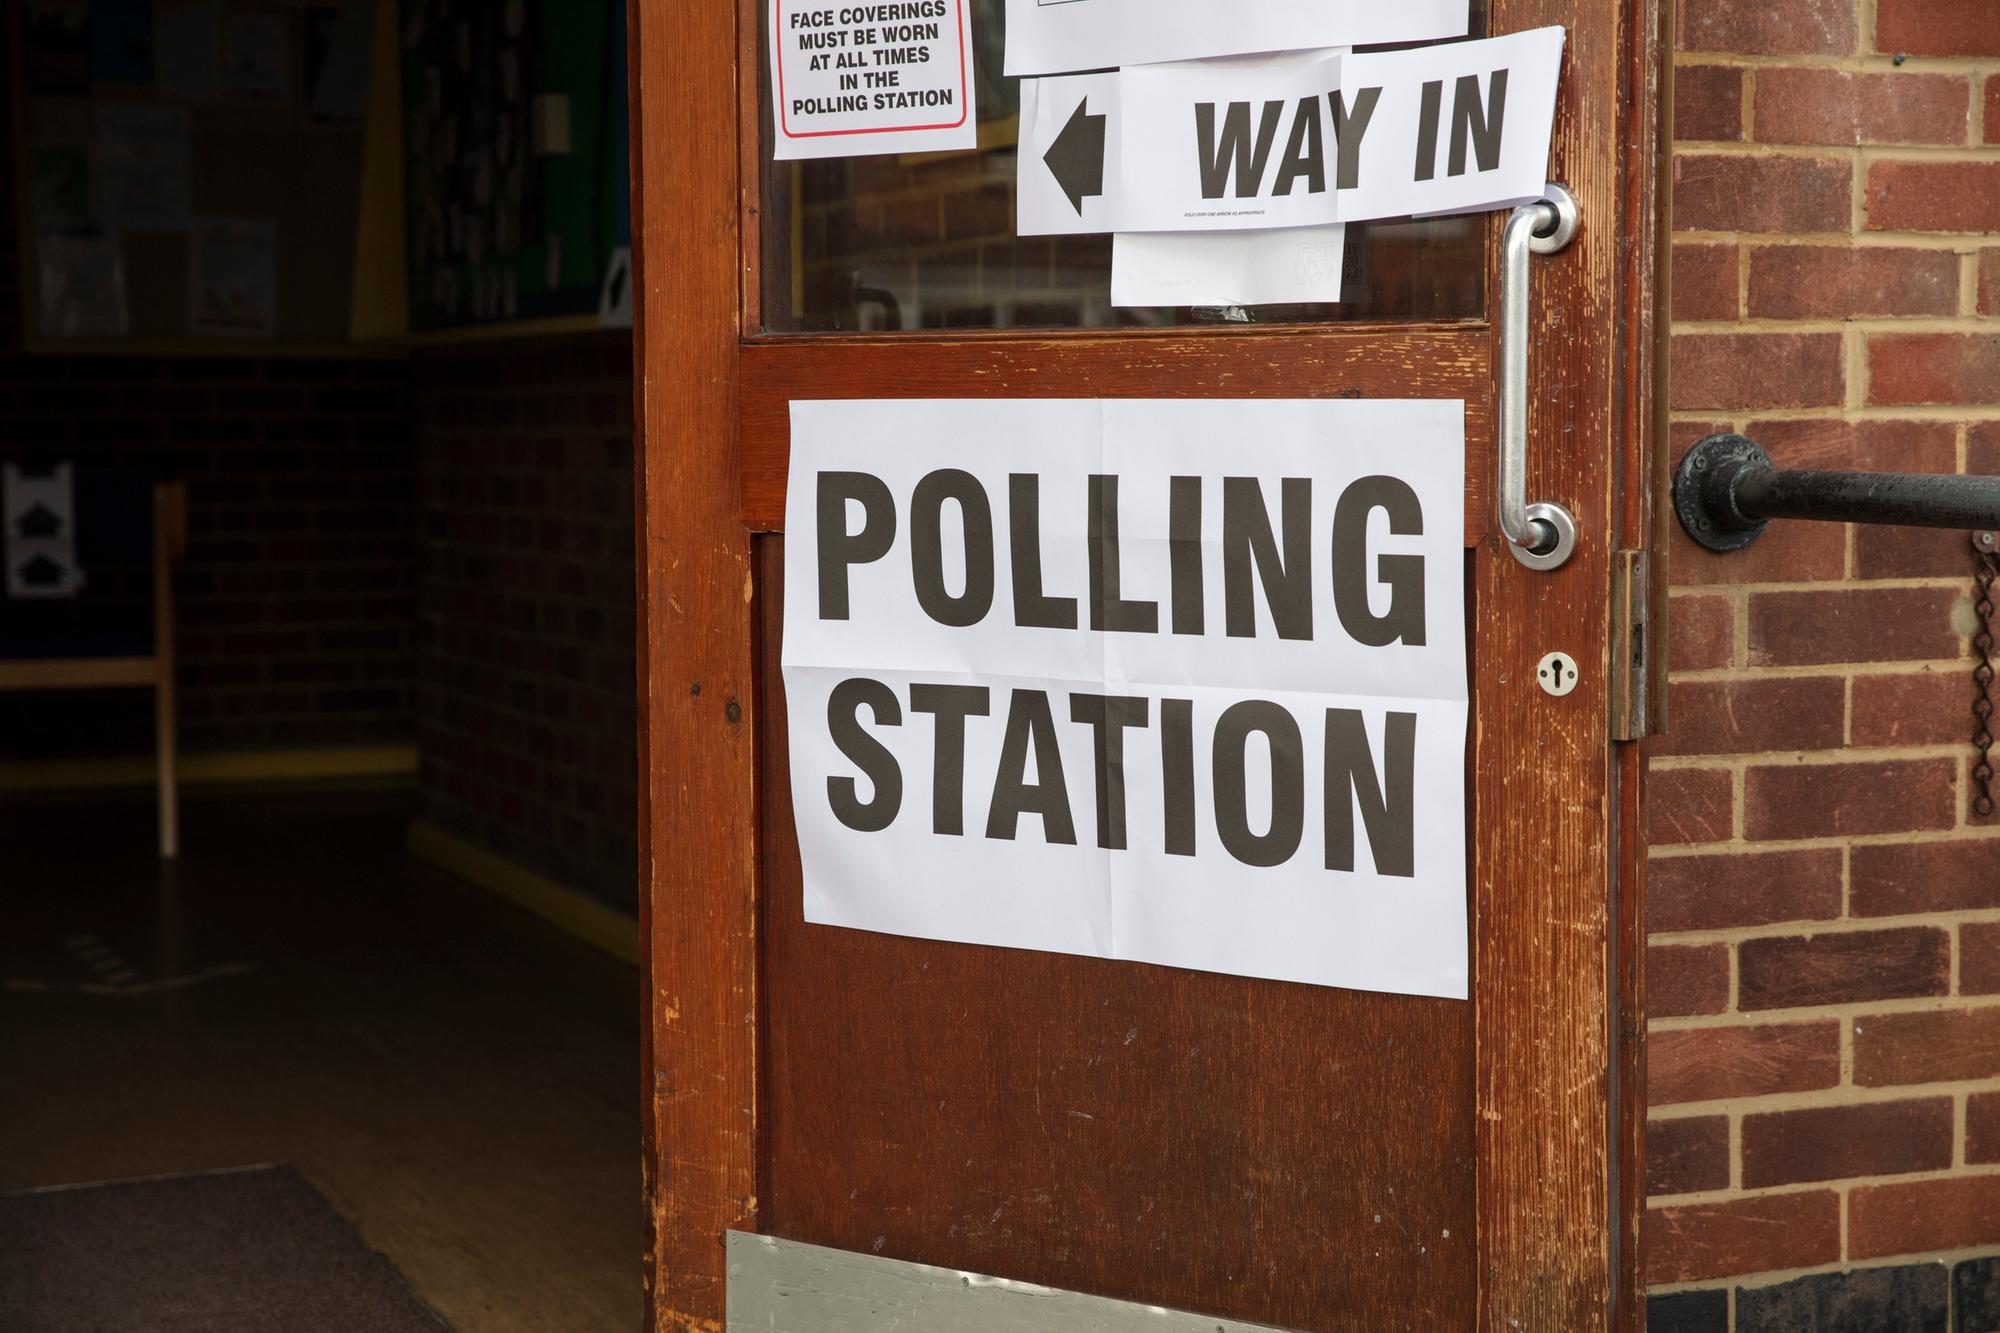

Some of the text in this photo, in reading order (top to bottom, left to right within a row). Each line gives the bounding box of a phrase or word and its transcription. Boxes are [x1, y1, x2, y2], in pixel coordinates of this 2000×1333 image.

[791, 0, 946, 29] FACE COVERINGS
[799, 23, 938, 50] MUST BE WORN
[810, 46, 929, 71] AT ALL TIMES
[840, 71, 899, 90] IN THE
[793, 89, 952, 115] POLLING STATION
[1195, 69, 1508, 198] WAY IN
[817, 469, 1426, 646] POLLING
[827, 678, 1416, 877] STATION
